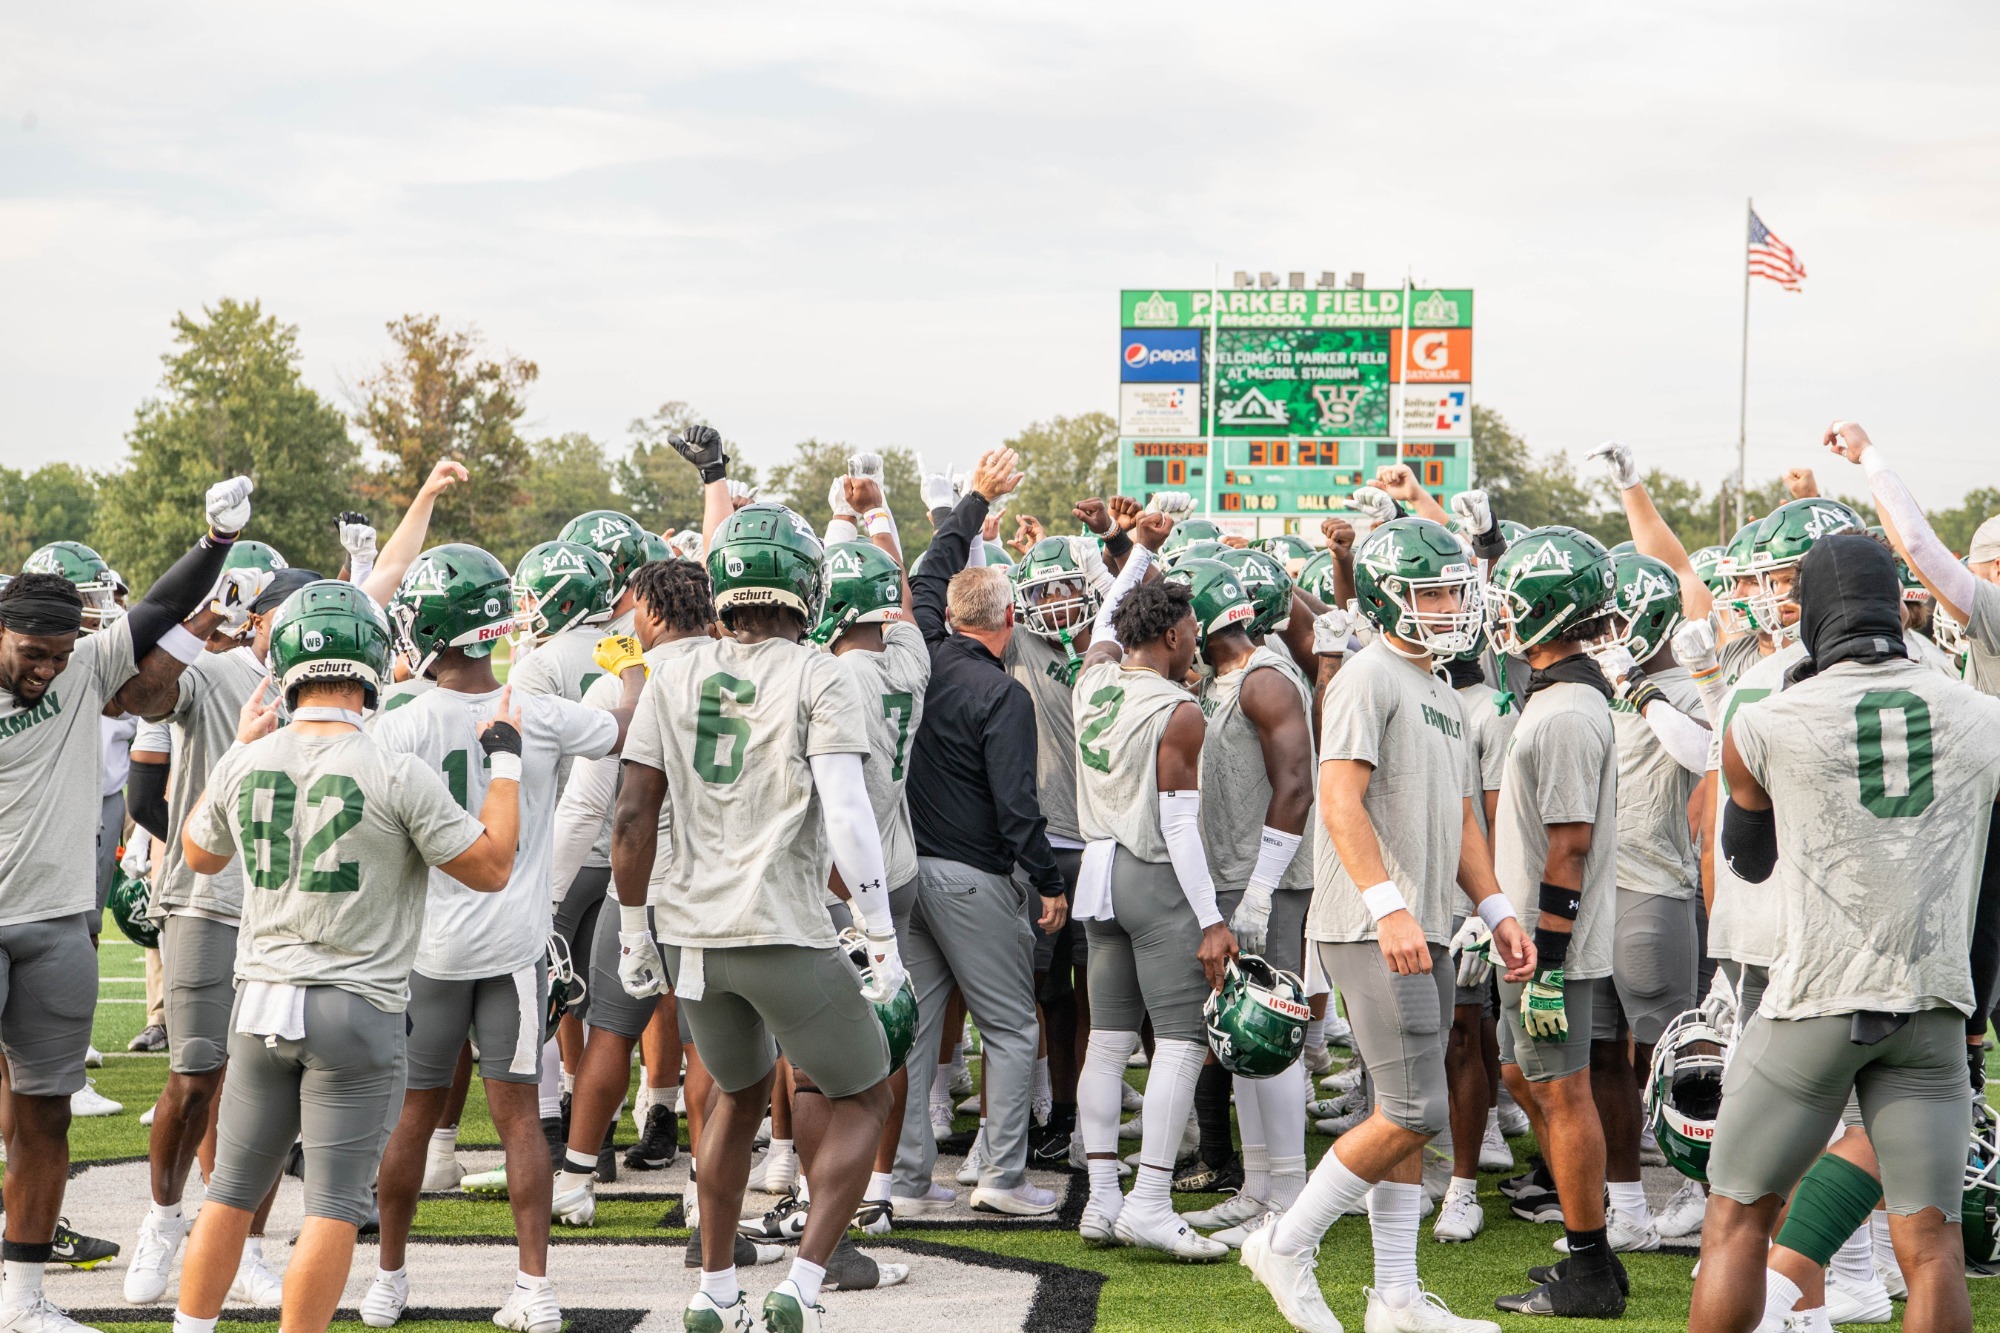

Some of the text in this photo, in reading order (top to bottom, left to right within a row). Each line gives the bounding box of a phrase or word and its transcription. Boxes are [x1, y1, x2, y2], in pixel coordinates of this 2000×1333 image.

[1191, 291, 1308, 314] PARKER
[1316, 291, 1400, 313] FIELD
[1220, 314, 1306, 327] McCOOL
[1311, 314, 1403, 327] STADIUM
[1149, 347, 1198, 365] pepsi
[1274, 352, 1290, 364] TO
[1295, 352, 1347, 364] PARKER
[1350, 352, 1387, 364] FIELD
[1228, 367, 1359, 379] AT McCOOL STADIUM
[1244, 495, 1259, 510] TO
[1261, 495, 1277, 510] GO
[1297, 495, 1327, 510] BALL
[590, 519, 630, 543] STATE
[542, 554, 588, 571] STATE
[728, 562, 742, 573] WB
[1521, 551, 1574, 570] STATE
[732, 589, 772, 601] schutt
[487, 604, 500, 613] WB
[305, 637, 322, 648] WB
[308, 661, 352, 674] schutt
[693, 672, 756, 784] 6
[1079, 685, 1125, 774] 2
[1420, 703, 1462, 741] FAMILY
[1855, 691, 1935, 818] 0
[238, 770, 365, 893] 82
[1683, 1123, 1714, 1139] dell
